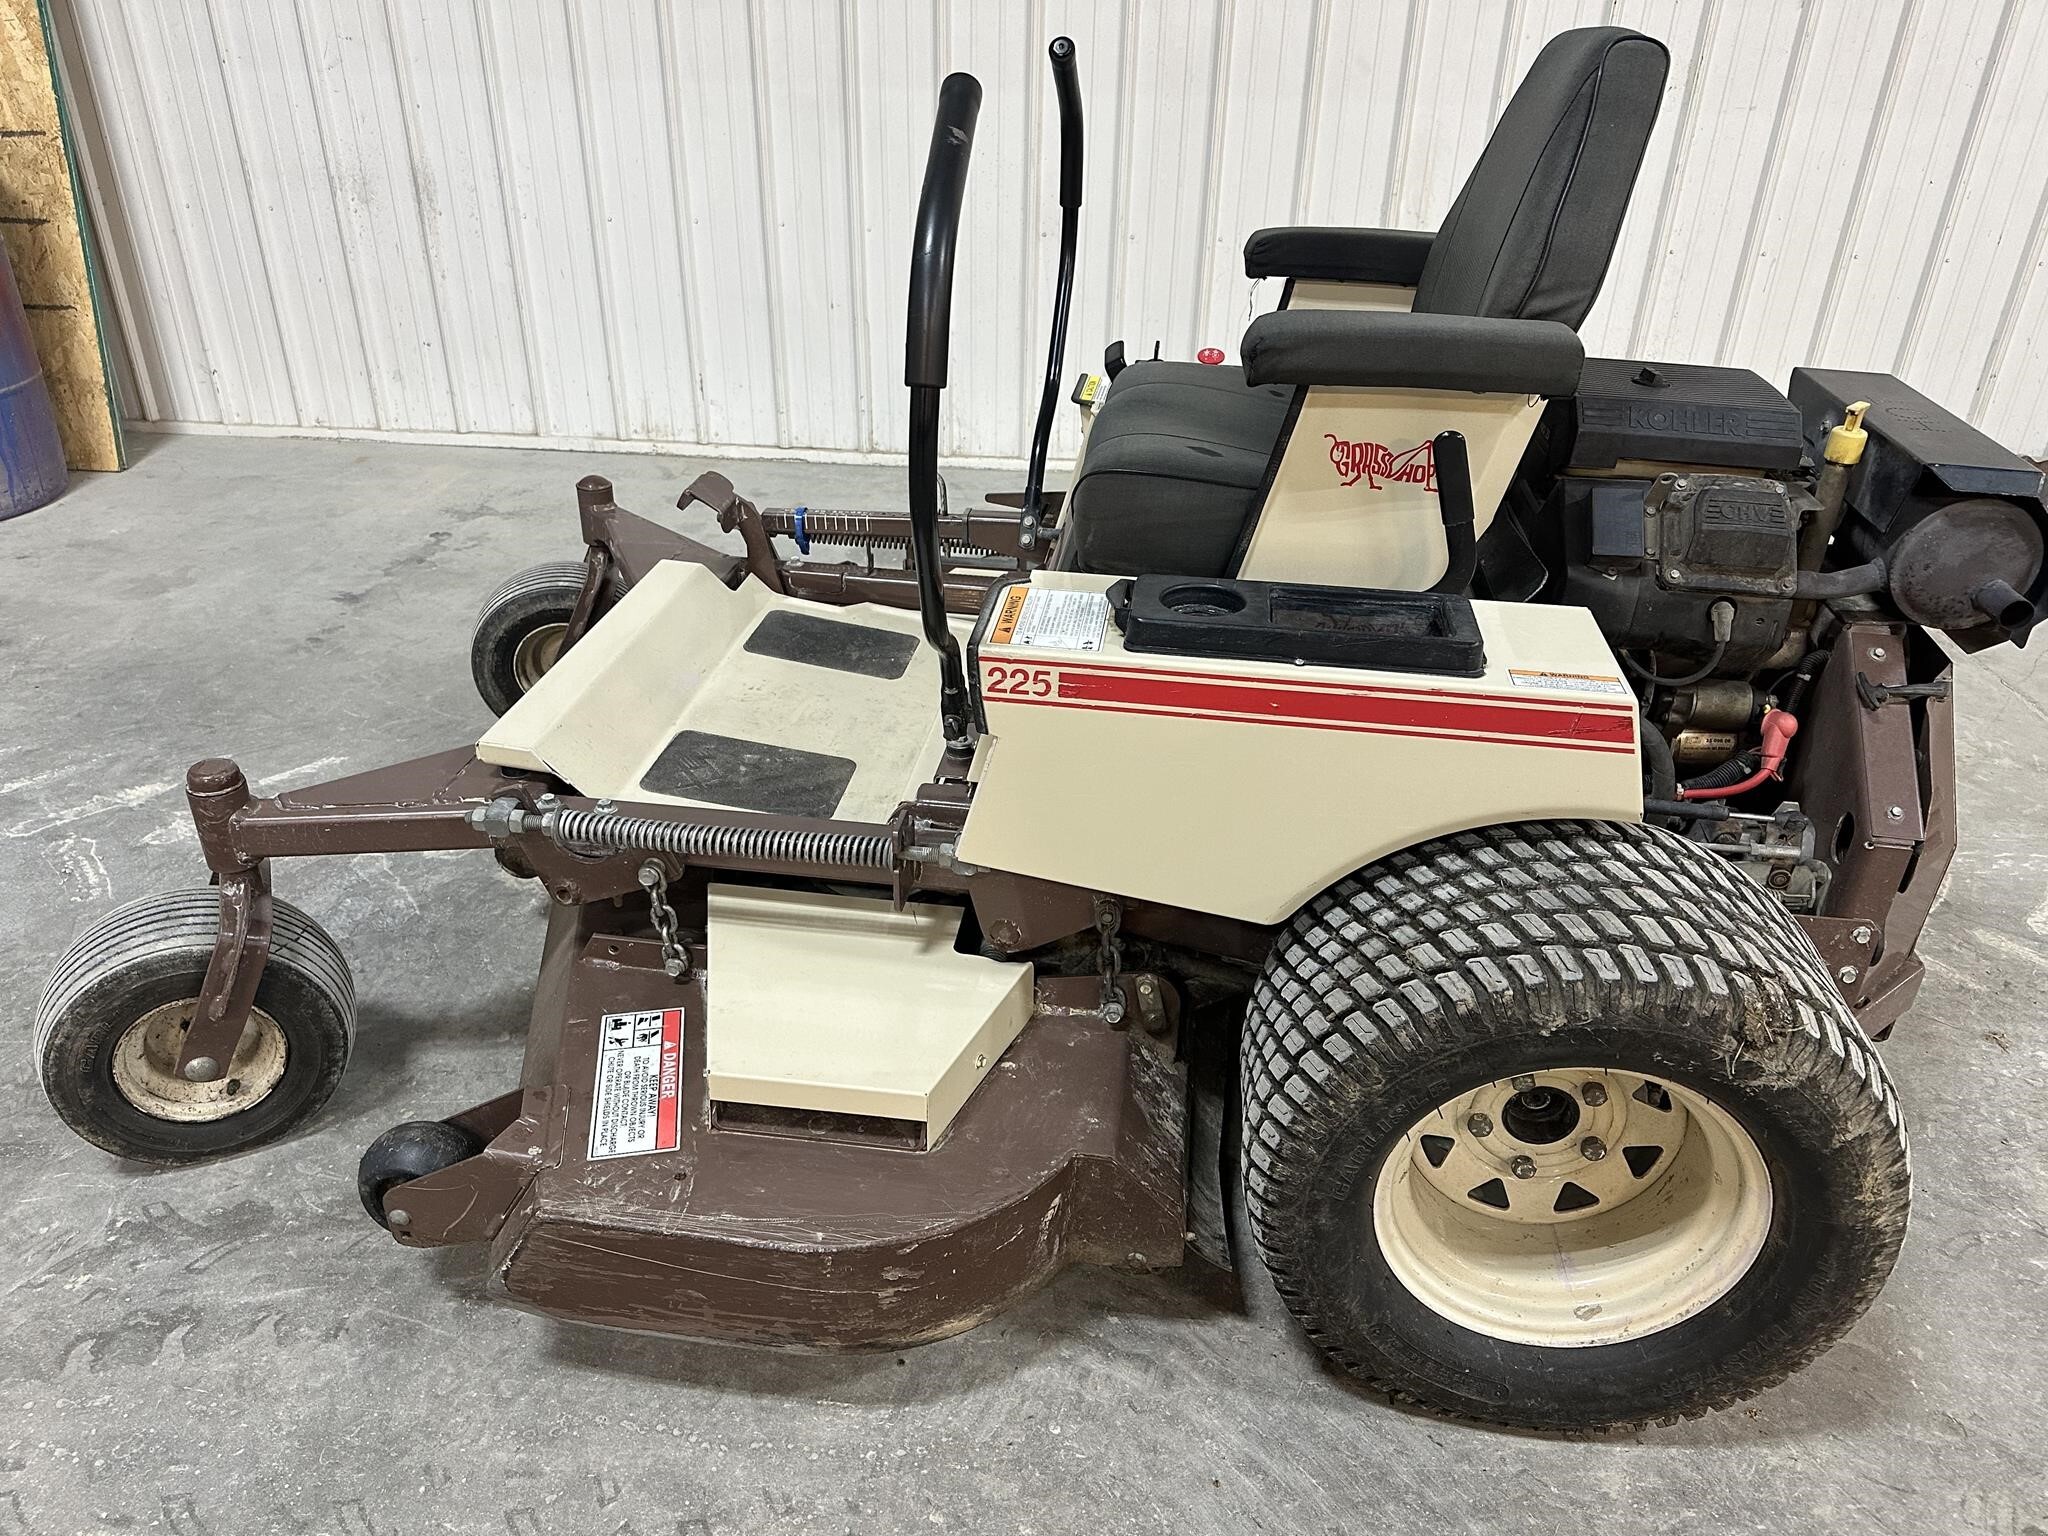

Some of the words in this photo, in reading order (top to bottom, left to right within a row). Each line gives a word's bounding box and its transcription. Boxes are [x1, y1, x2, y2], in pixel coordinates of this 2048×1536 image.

[1628, 405, 1746, 437] KOHLER
[1325, 436, 1438, 491] GRASSHOP
[1720, 502, 1772, 522] OHV
[1002, 595, 1022, 624] WARNING
[987, 667, 1052, 698] 225
[616, 1051, 624, 1068] NEVER
[633, 1056, 641, 1073] DEATH
[606, 1075, 614, 1083] OR
[614, 1069, 623, 1091] OPERATE
[624, 1071, 631, 1079] OR
[632, 1074, 640, 1090] FROM
[641, 1066, 649, 1083] AVOID
[650, 1075, 658, 1091] KEEP
[661, 1053, 676, 1099] DANGER
[612, 1093, 621, 1117] WITHOUT
[630, 1091, 639, 1116] THROWN
[639, 1084, 647, 1107] SERIOUS
[648, 1093, 657, 1117] AWAY!
[602, 1097, 611, 1119] SHIELDS
[638, 1108, 646, 1127] INJURY
[608, 1119, 618, 1153] DISCHARGE
[628, 1117, 637, 1142] OBJECTS
[638, 1130, 645, 1139] OR
[1333, 1079, 1451, 1201] CARLISLE
